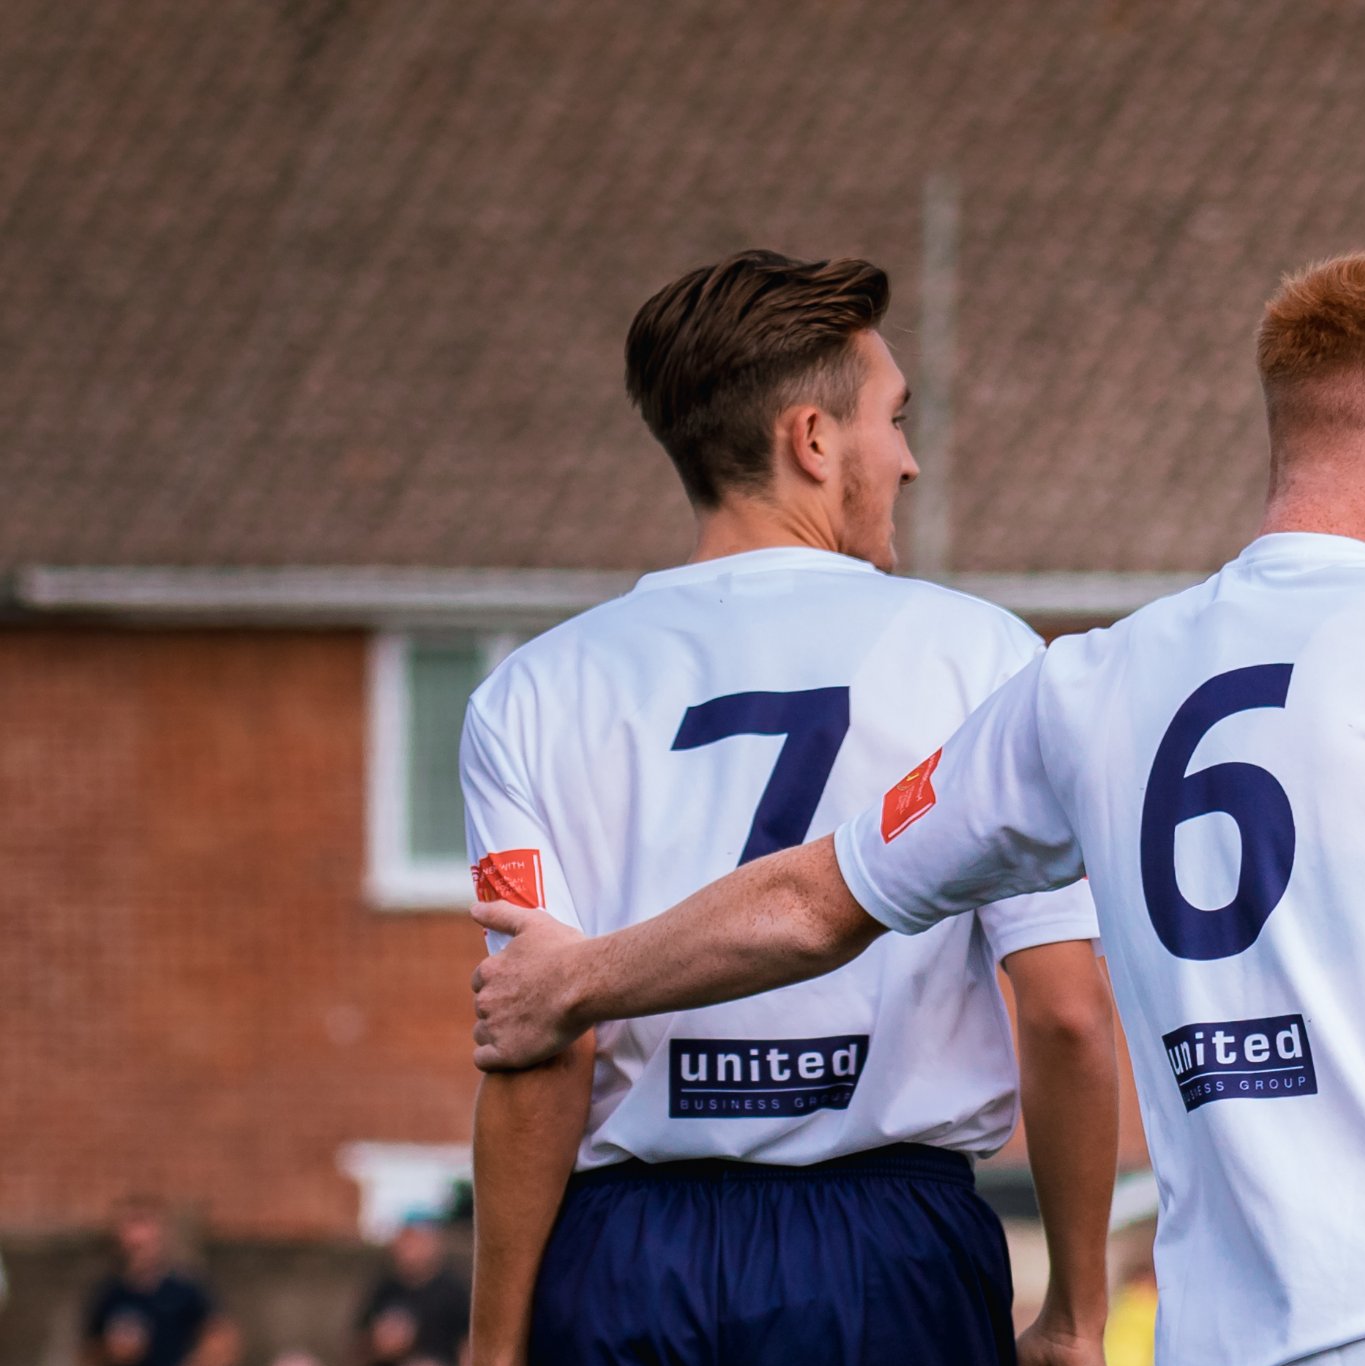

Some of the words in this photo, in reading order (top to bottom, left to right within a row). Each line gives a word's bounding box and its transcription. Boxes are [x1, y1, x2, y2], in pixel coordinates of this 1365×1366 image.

[670, 685, 850, 868] 7
[1140, 662, 1296, 961] 6
[680, 1043, 858, 1082] united
[1168, 1023, 1304, 1076] united
[680, 1098, 780, 1110] BUSINESS
[1239, 1076, 1307, 1091] GROUP
